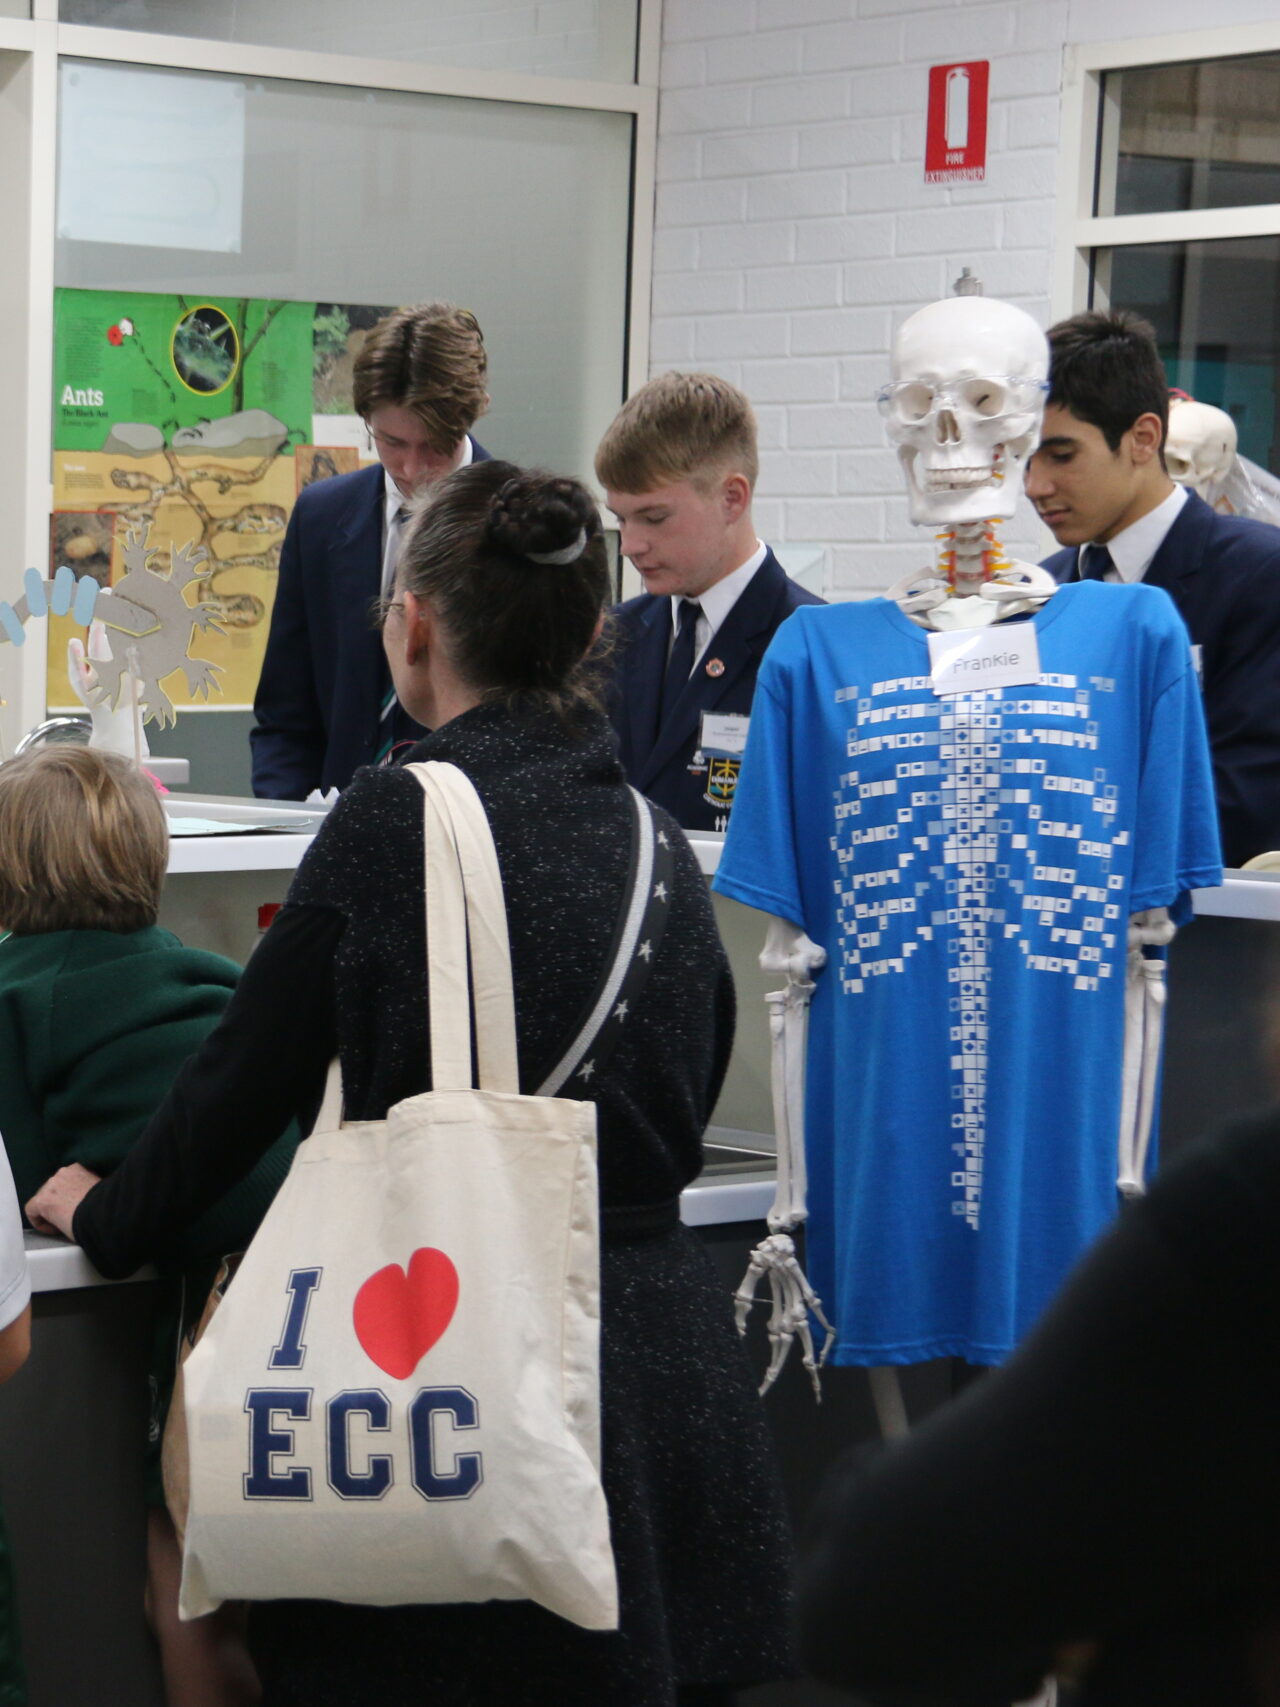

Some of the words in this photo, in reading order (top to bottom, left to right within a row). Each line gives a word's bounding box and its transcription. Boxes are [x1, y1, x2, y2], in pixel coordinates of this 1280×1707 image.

[945, 152, 965, 165] FIRE
[61, 384, 104, 407] Ants
[952, 651, 1020, 674] Frankie
[267, 1266, 324, 1370] I
[242, 1385, 484, 1502] ECC
